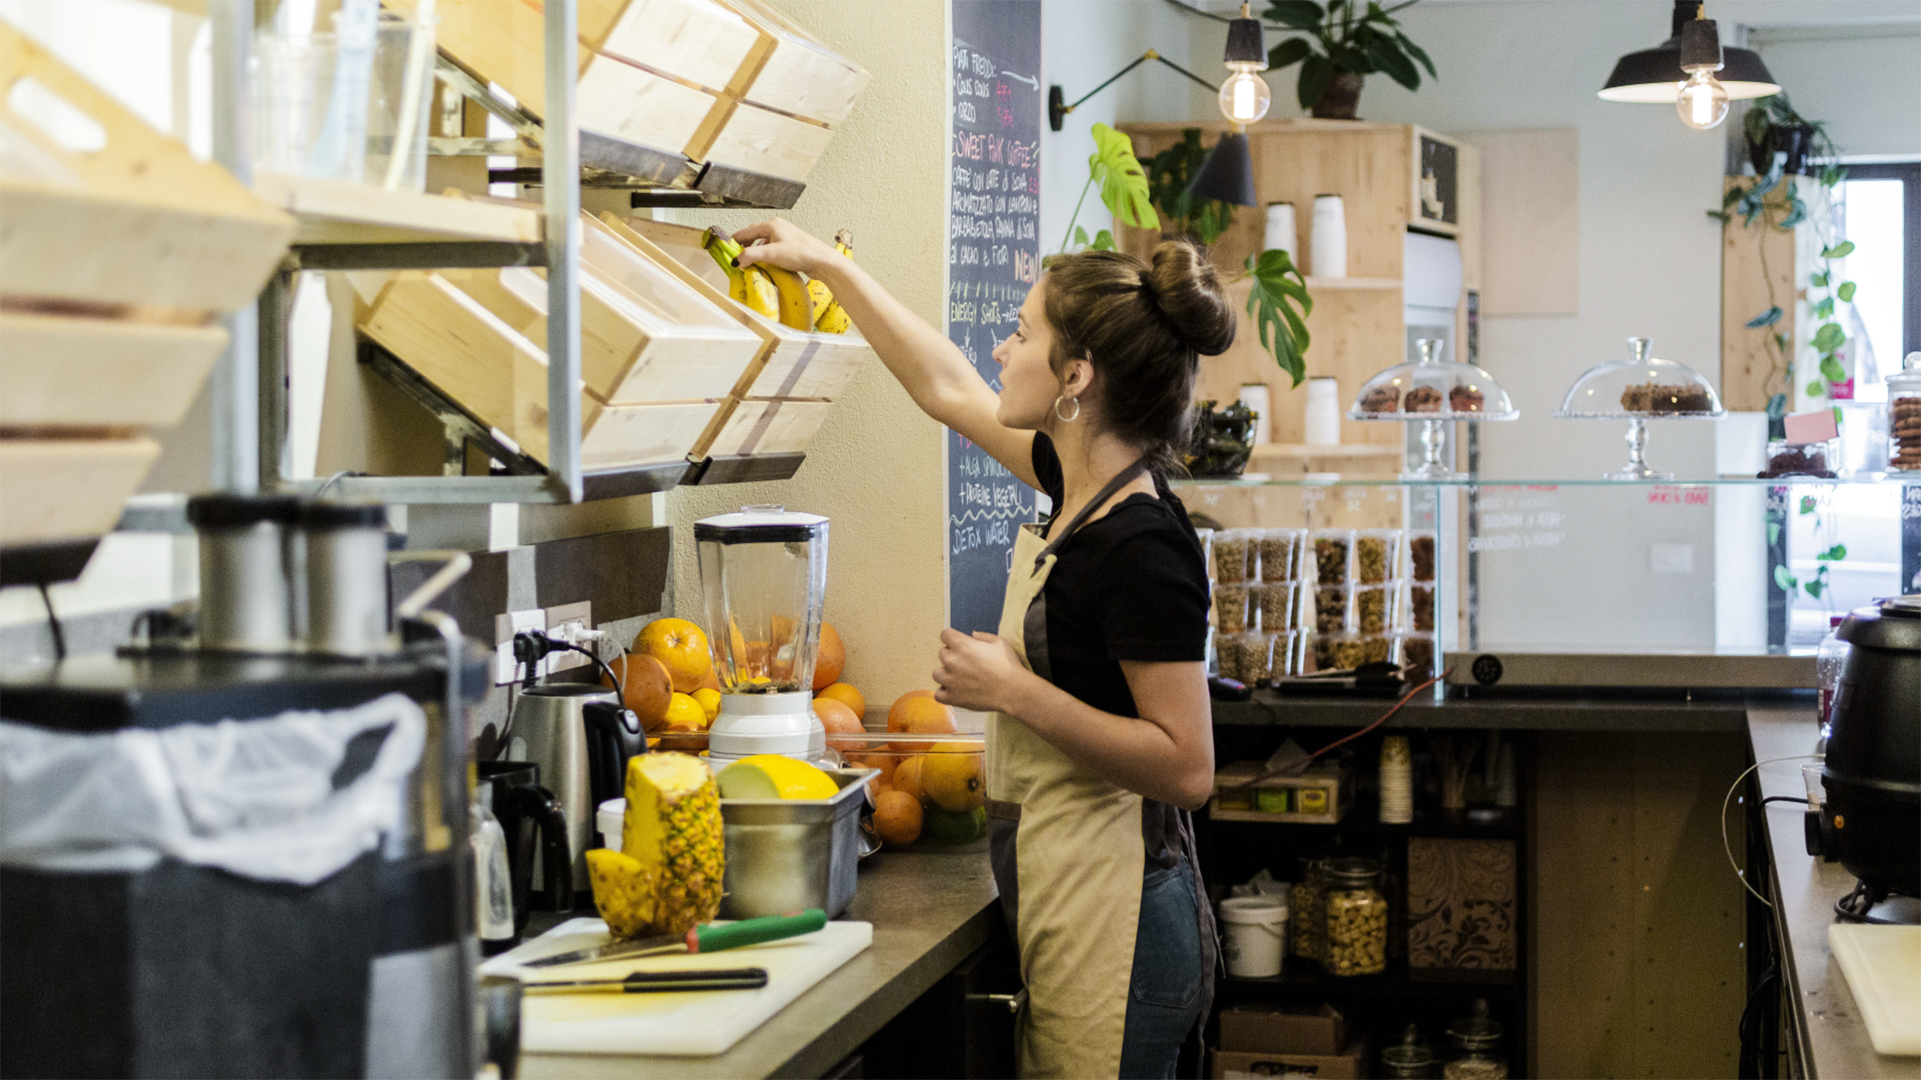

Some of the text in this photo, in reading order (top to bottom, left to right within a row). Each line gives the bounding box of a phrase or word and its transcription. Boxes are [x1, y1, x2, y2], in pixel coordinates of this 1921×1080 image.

[956, 131, 986, 161] SWEET
[951, 300, 977, 328] ENERGY
[952, 520, 1010, 555] DETOX WATER
